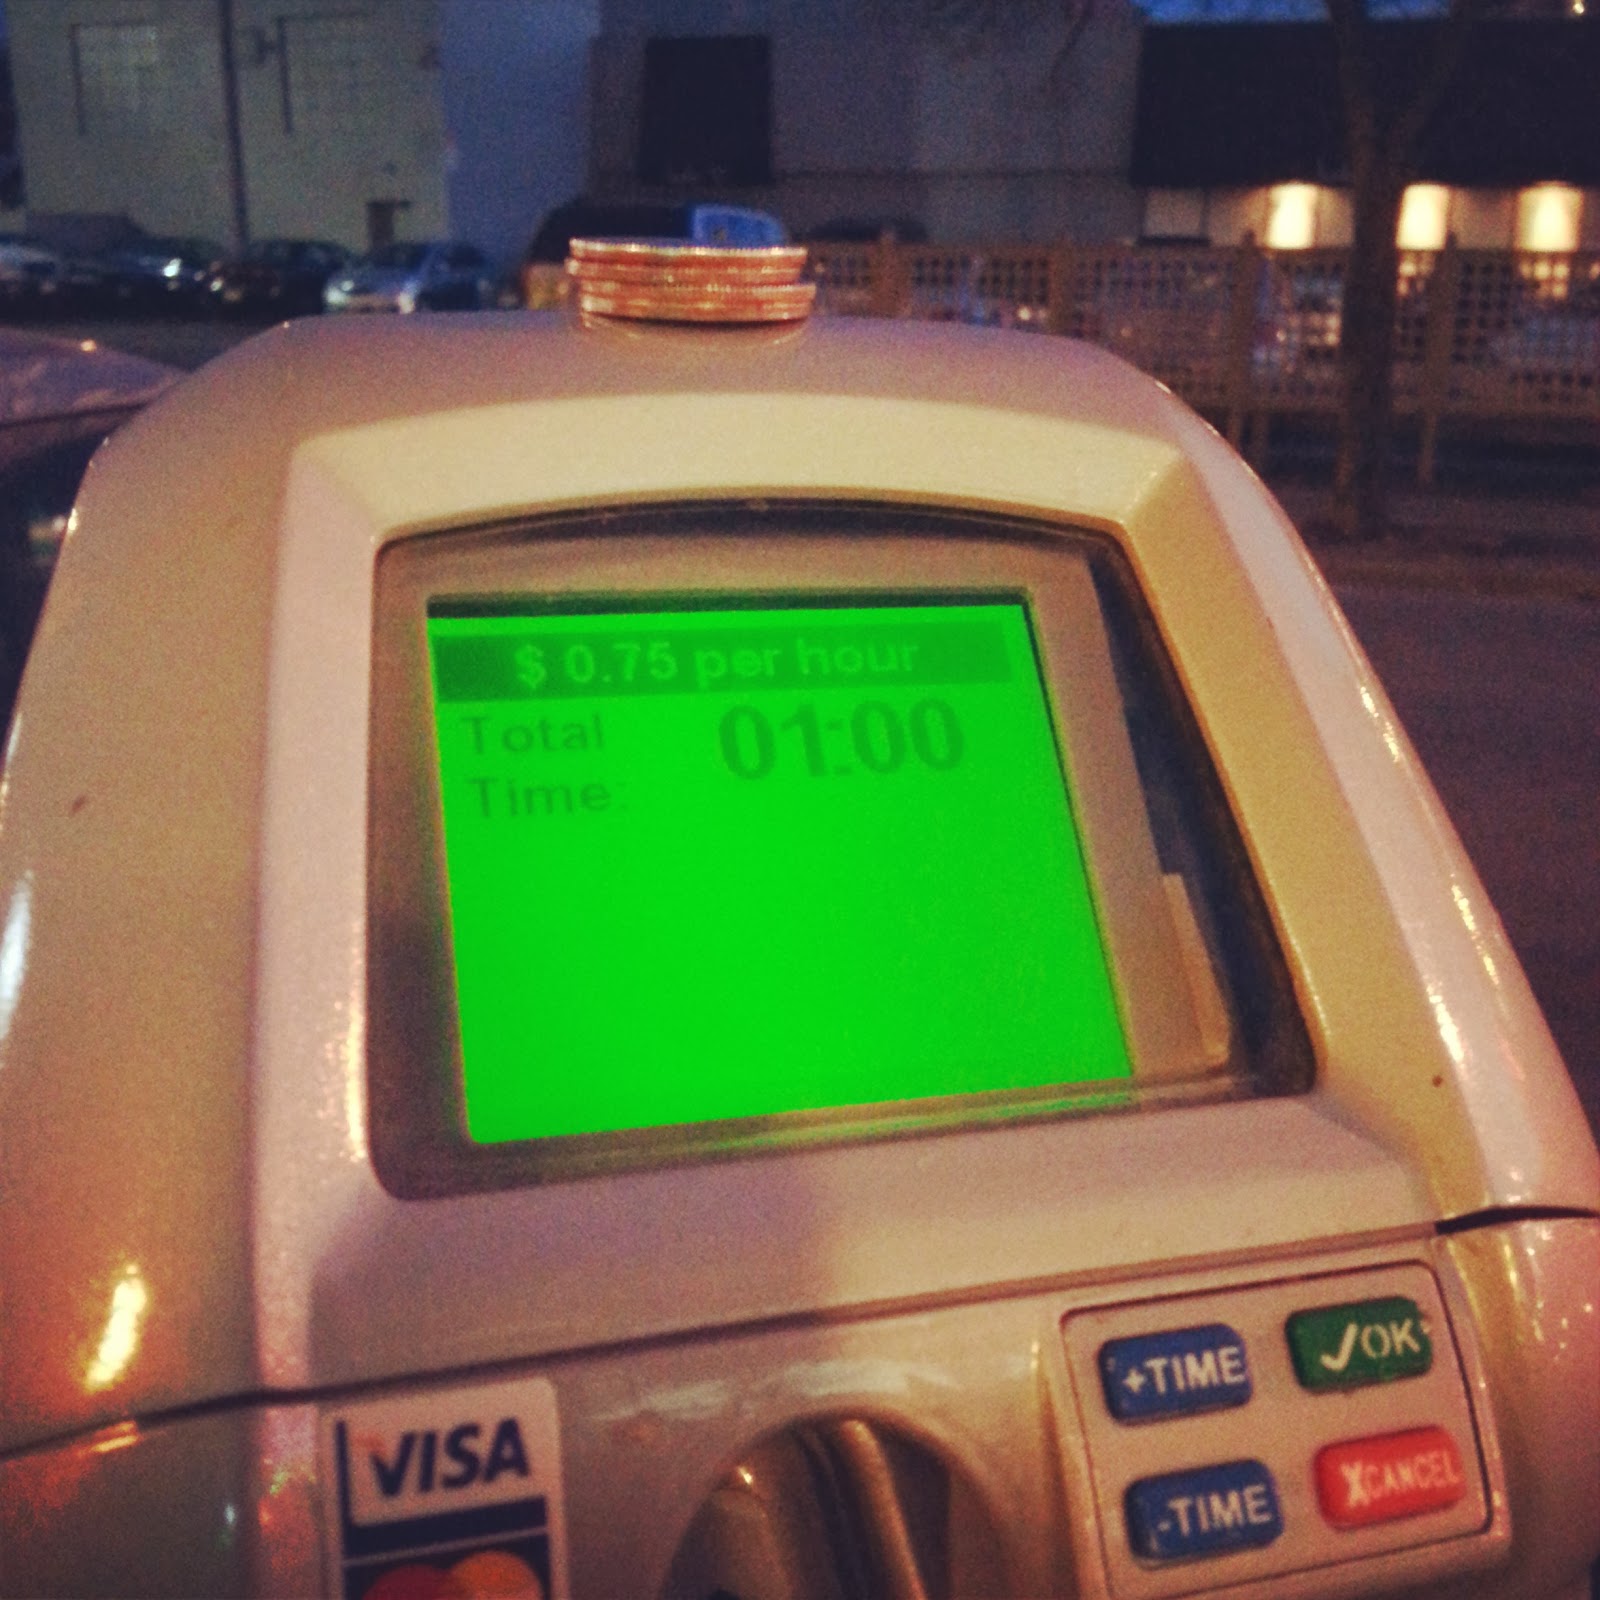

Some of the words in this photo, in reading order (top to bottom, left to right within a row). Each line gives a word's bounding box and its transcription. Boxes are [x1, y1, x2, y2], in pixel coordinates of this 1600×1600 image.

[514, 643, 547, 690] $
[563, 641, 678, 683] 0.75
[694, 649, 781, 692] per
[797, 638, 919, 676] hour
[462, 713, 606, 754] Total
[718, 698, 965, 780] 01:00
[370, 1415, 529, 1497] VISA
